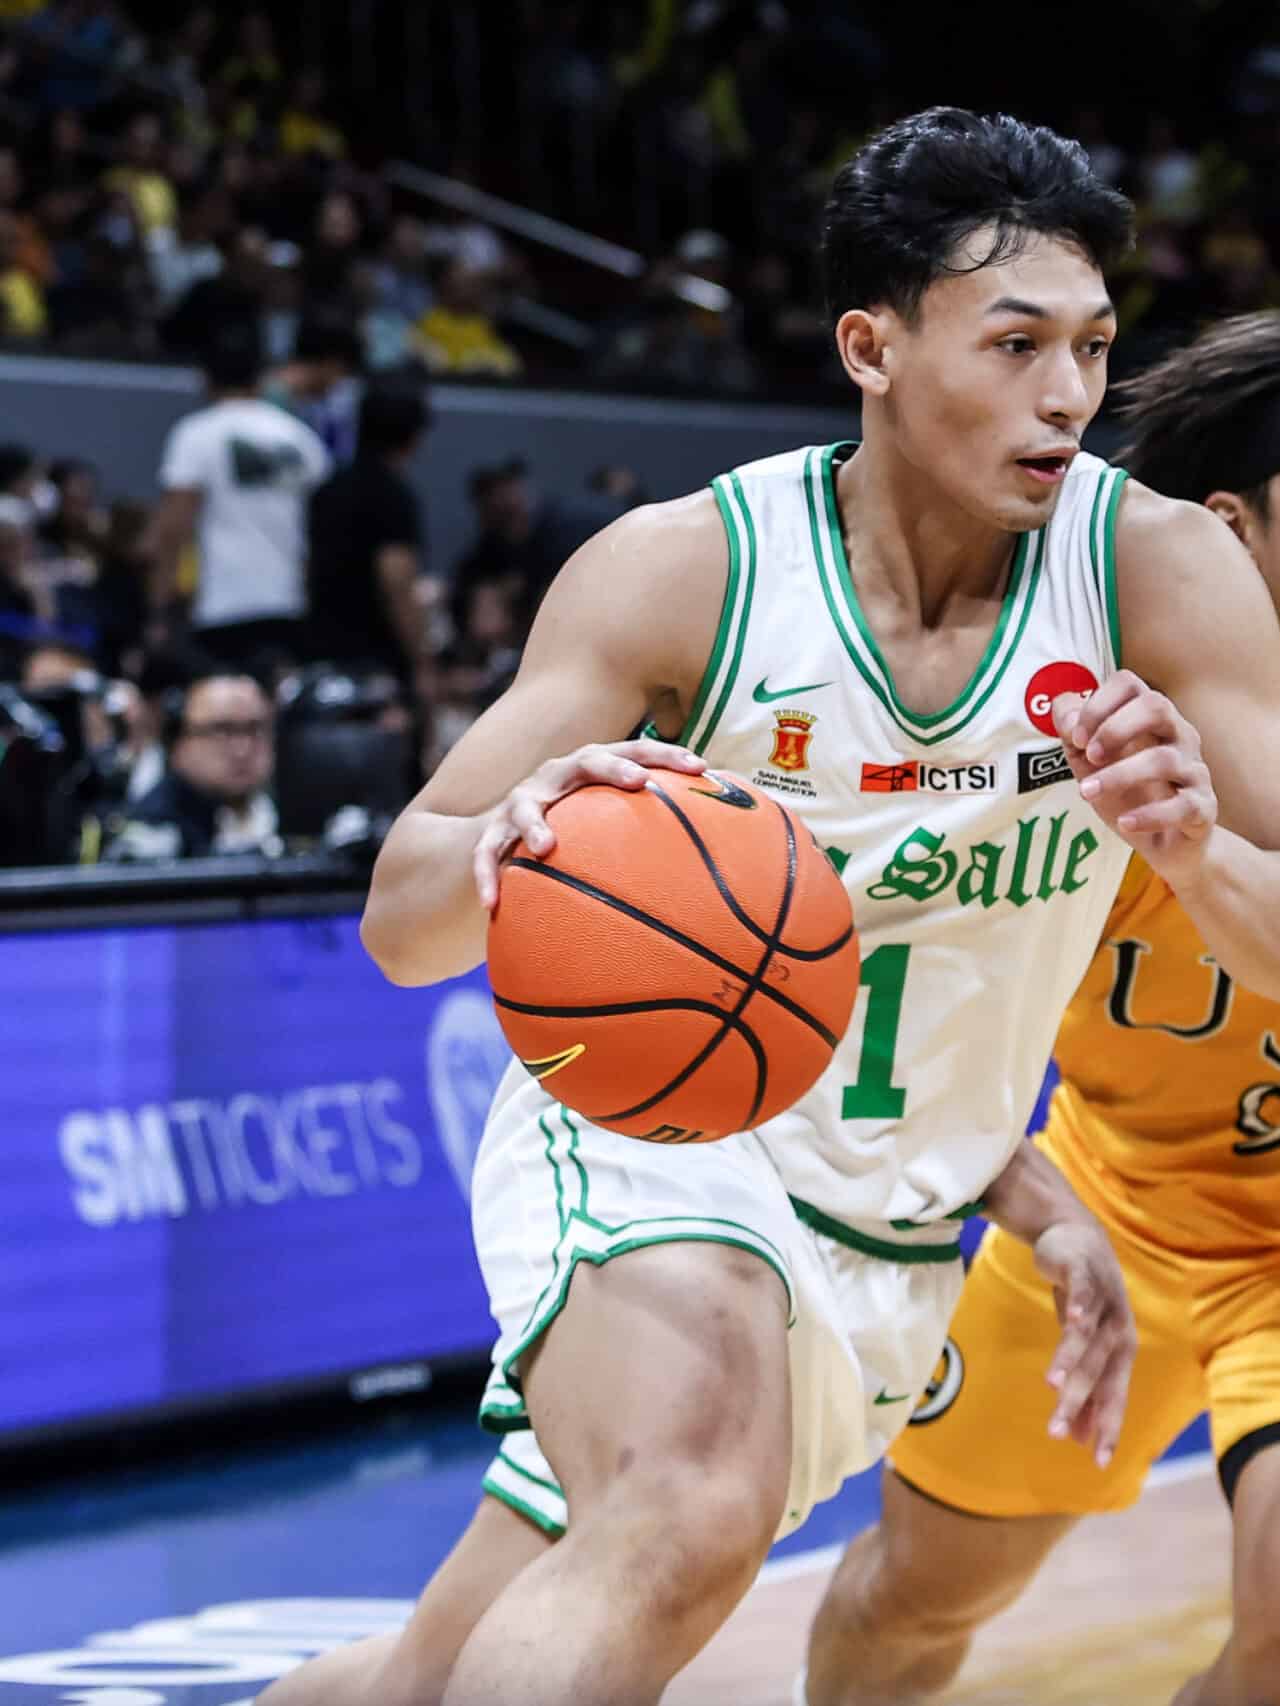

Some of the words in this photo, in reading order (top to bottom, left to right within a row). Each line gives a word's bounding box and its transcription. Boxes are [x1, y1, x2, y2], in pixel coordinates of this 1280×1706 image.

[757, 770, 778, 781] SAN
[919, 764, 995, 791] ICTSI
[866, 810, 1099, 909] Salle
[841, 943, 911, 1121] 1
[58, 1075, 424, 1227] SMTICKETS
